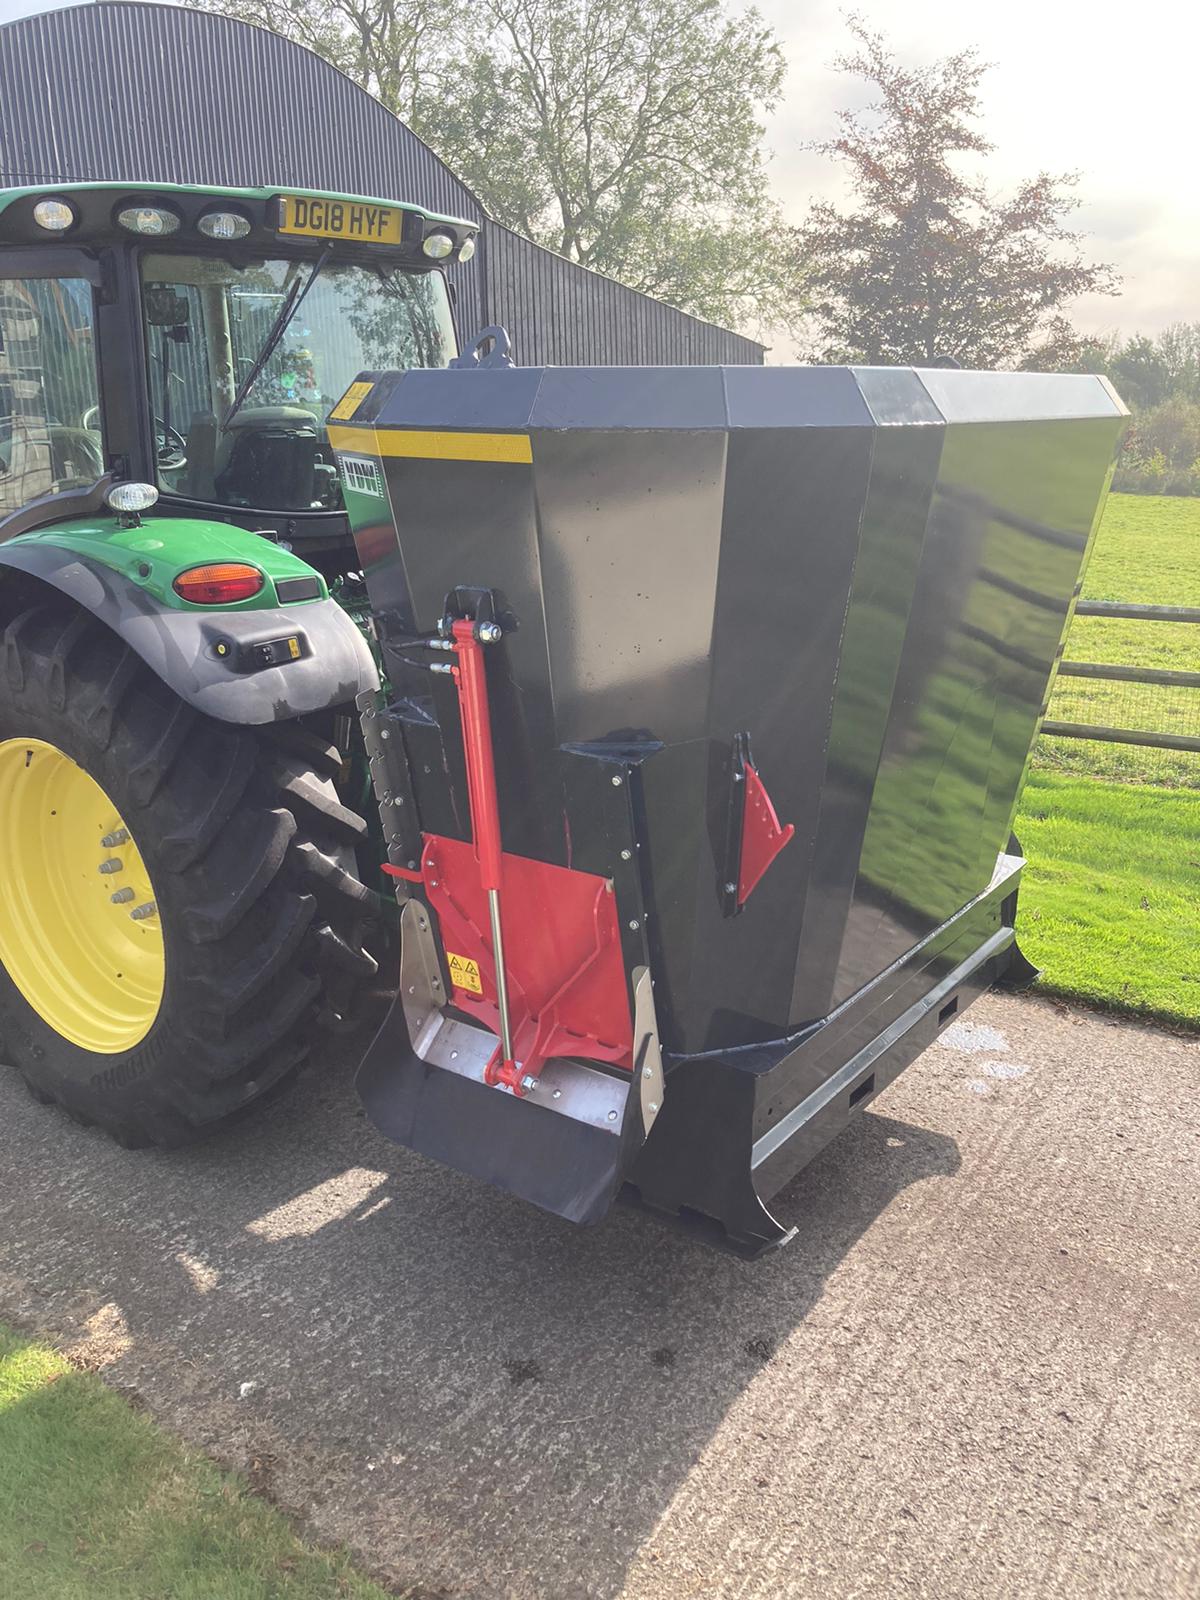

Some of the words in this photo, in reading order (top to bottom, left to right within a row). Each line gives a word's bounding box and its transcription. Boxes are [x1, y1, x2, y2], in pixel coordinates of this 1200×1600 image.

[294, 198, 344, 232] DG18
[350, 206, 391, 237] HYF
[391, 832, 403, 851] 2
